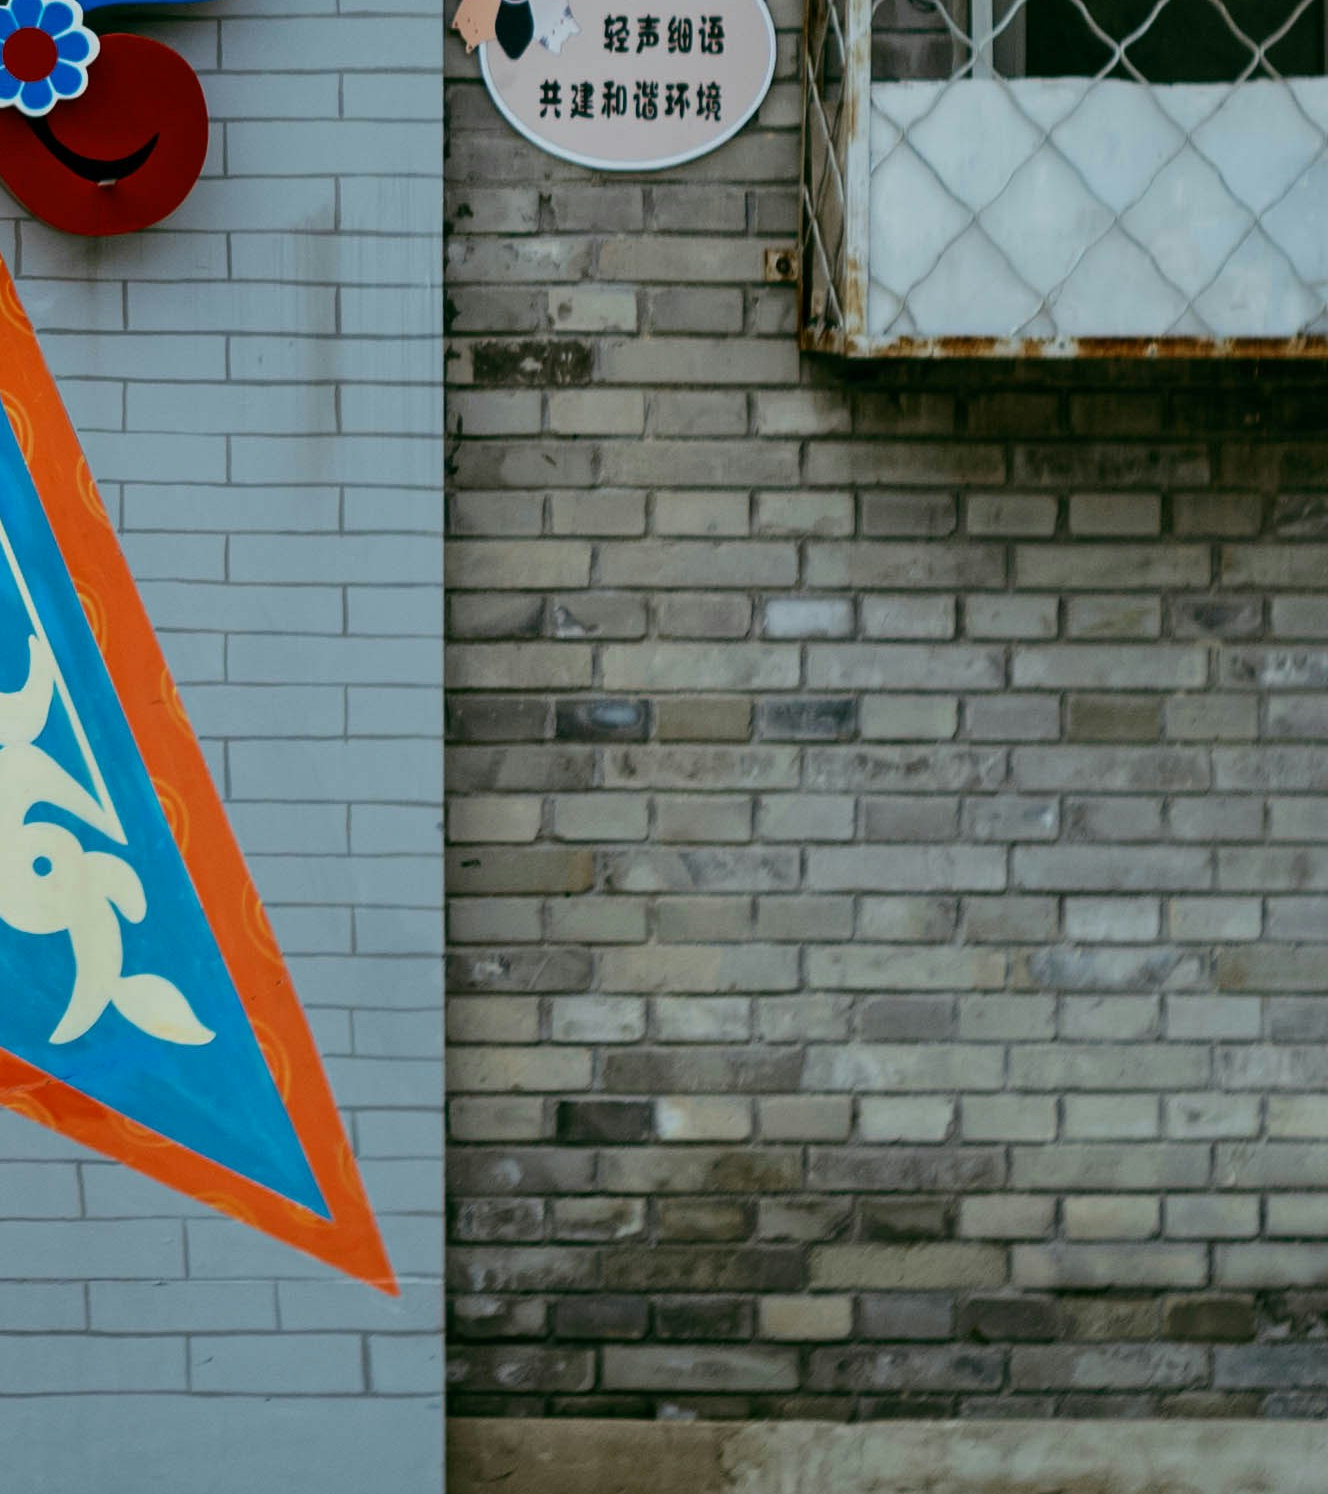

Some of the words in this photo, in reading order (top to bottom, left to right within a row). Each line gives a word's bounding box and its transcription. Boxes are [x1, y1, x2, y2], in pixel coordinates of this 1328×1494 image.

[603, 14, 725, 55] 轻声细语
[539, 79, 722, 122] 共建和谐环境
